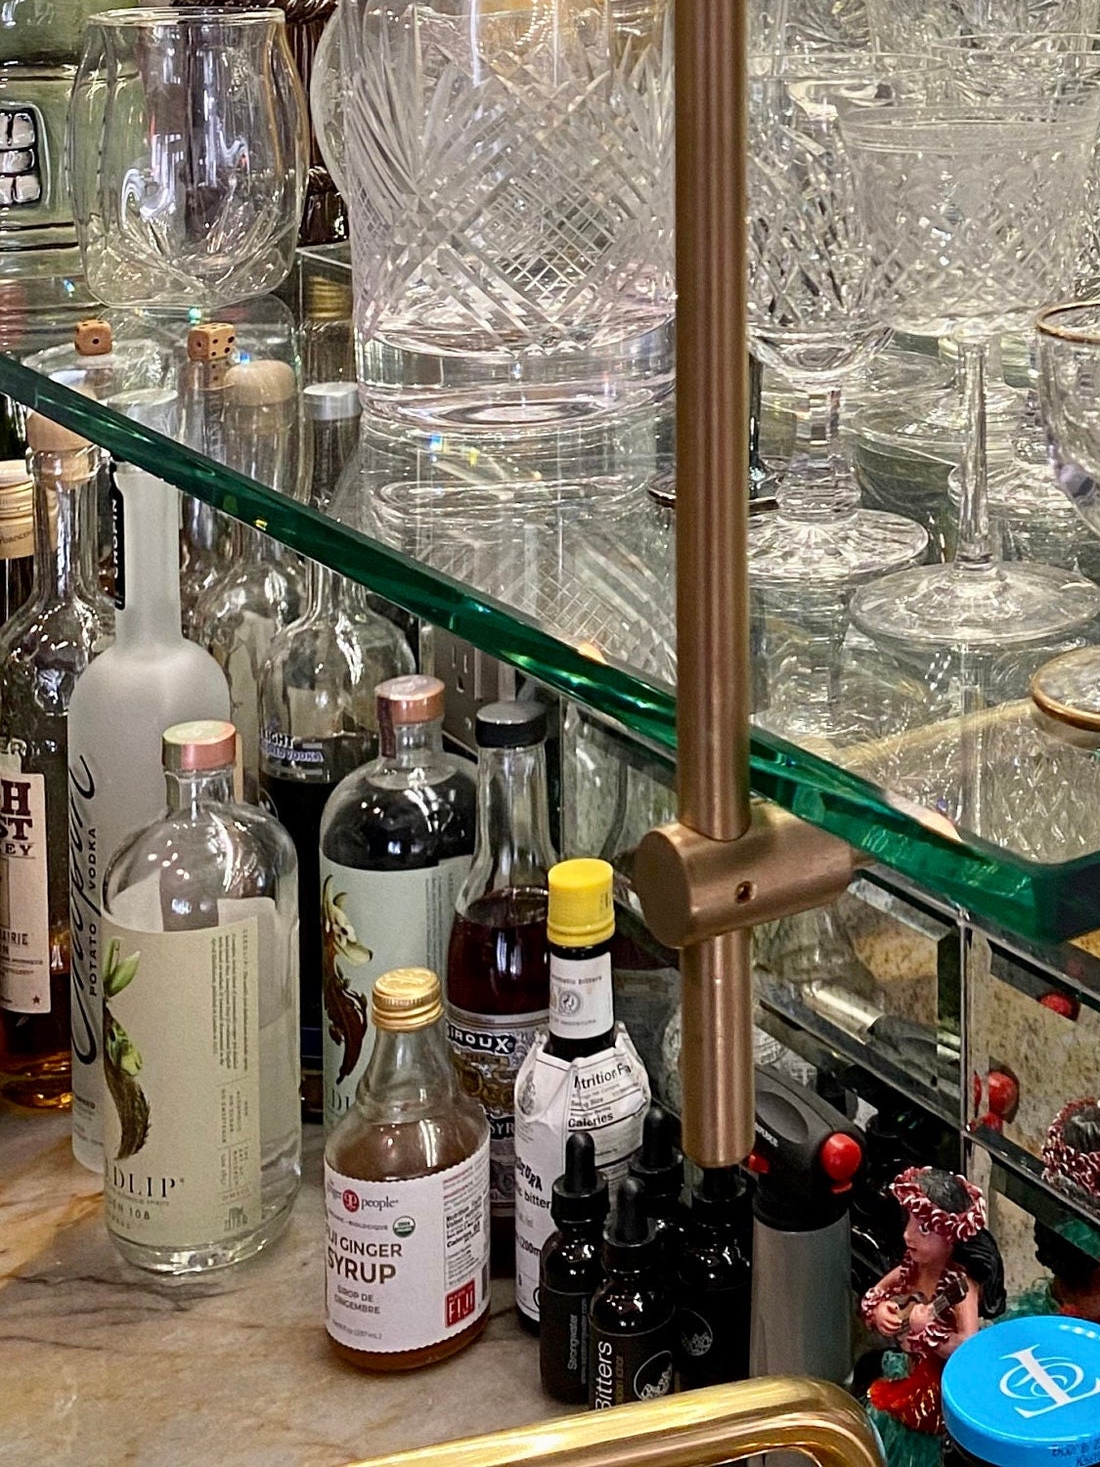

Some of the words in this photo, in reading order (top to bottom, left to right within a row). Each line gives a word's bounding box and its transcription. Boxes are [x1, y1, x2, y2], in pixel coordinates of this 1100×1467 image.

[286, 750, 324, 763] VODKA
[88, 827, 97, 891] VODKA
[88, 922, 97, 997] POTATO
[568, 1112, 614, 1129] Calories
[105, 1158, 176, 1199] DLIP
[361, 1195, 394, 1212] people
[339, 1236, 403, 1258] GINGER
[327, 1245, 397, 1285] SYRUP
[361, 1293, 375, 1303] DE
[449, 1290, 474, 1323] FIJI
[595, 1341, 613, 1412] Bitters
